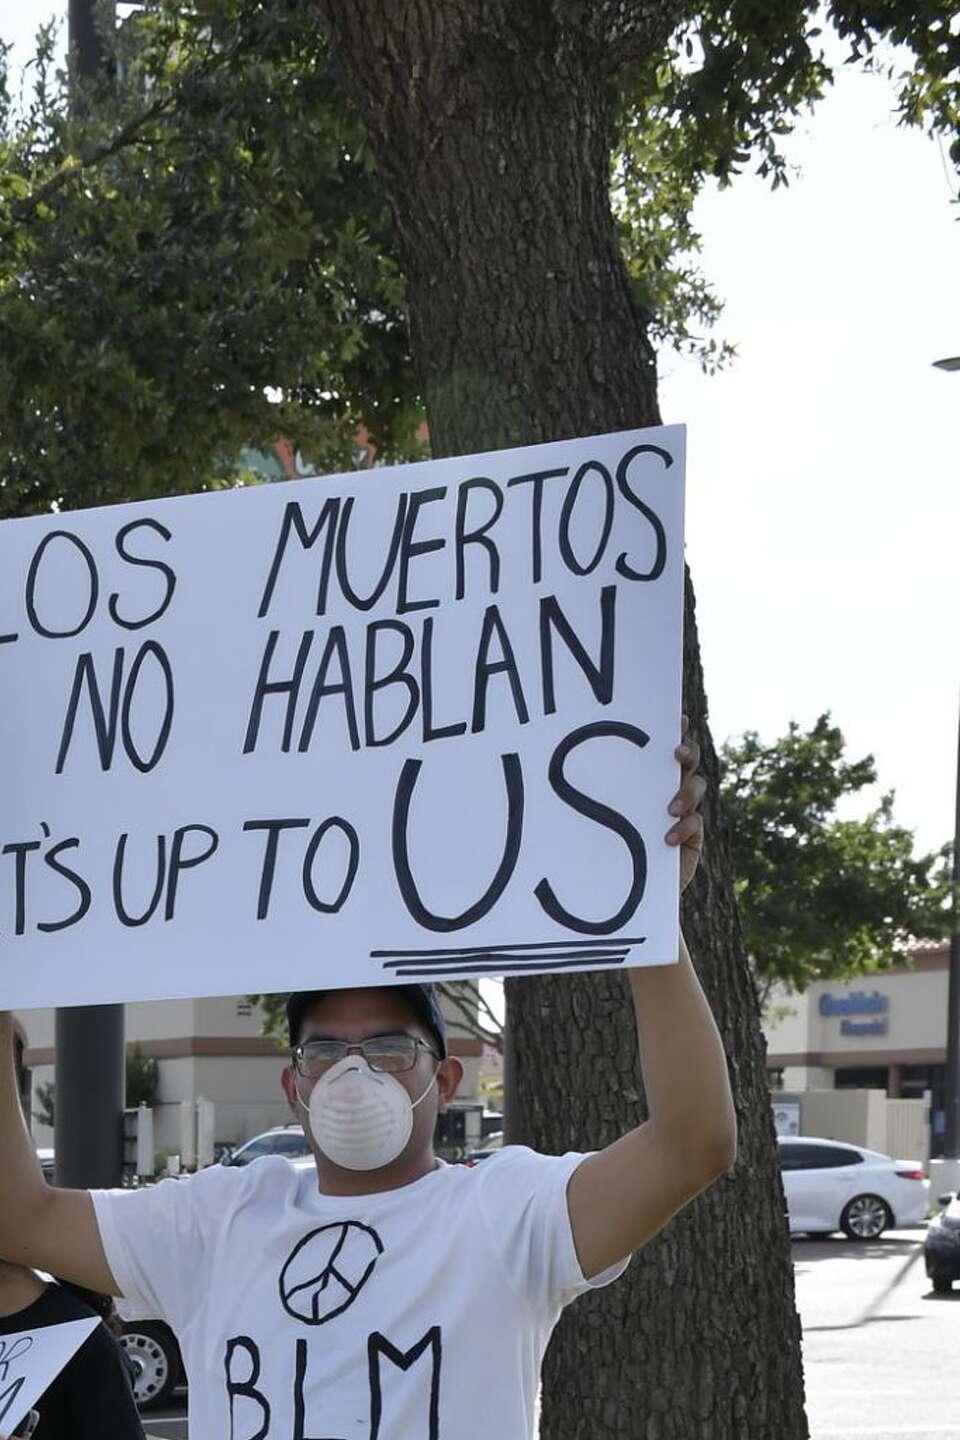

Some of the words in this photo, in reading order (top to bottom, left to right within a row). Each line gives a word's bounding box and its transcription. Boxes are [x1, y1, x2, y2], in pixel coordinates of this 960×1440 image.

[257, 443, 674, 619] MUERTOS
[54, 639, 174, 775] NO
[242, 585, 617, 755] HABLAN
[112, 823, 219, 928] UP
[242, 816, 360, 920] TO
[392, 720, 651, 936] US
